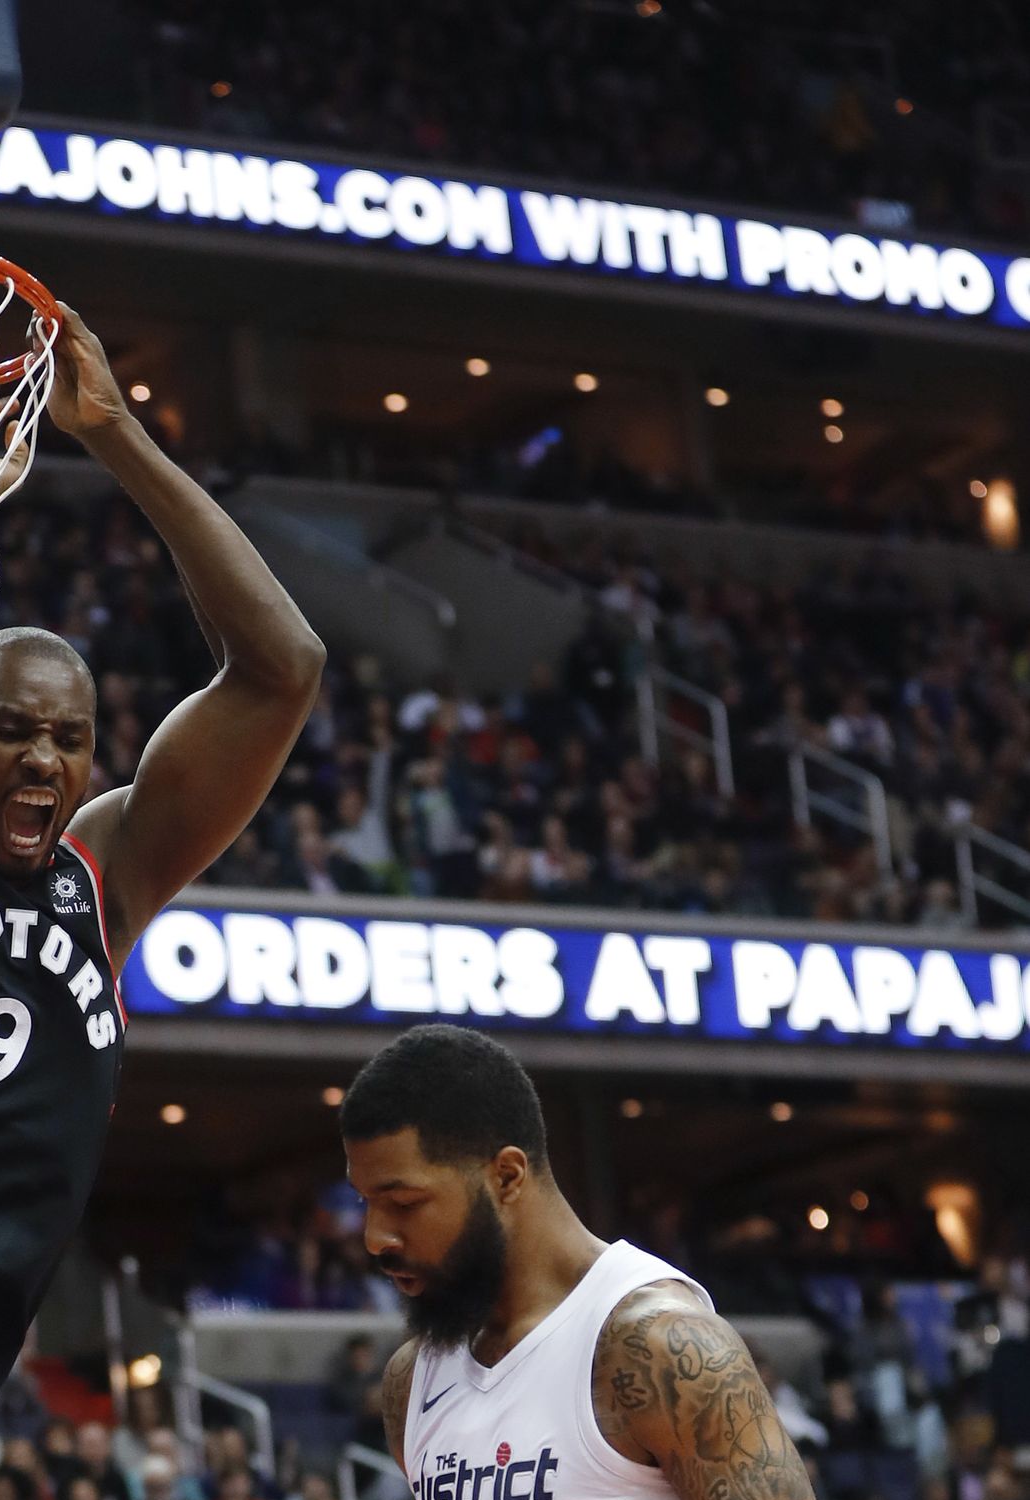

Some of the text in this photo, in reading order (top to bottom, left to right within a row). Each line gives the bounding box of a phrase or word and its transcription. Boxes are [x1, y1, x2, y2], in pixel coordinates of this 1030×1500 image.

[520, 191, 728, 280] WITH
[737, 219, 995, 315] PROMO
[74, 901, 91, 913] Life
[142, 910, 566, 1019] ORDERS
[584, 932, 712, 1026] AT
[734, 939, 1030, 1041] PAPAJ
[436, 1452, 458, 1471] THE
